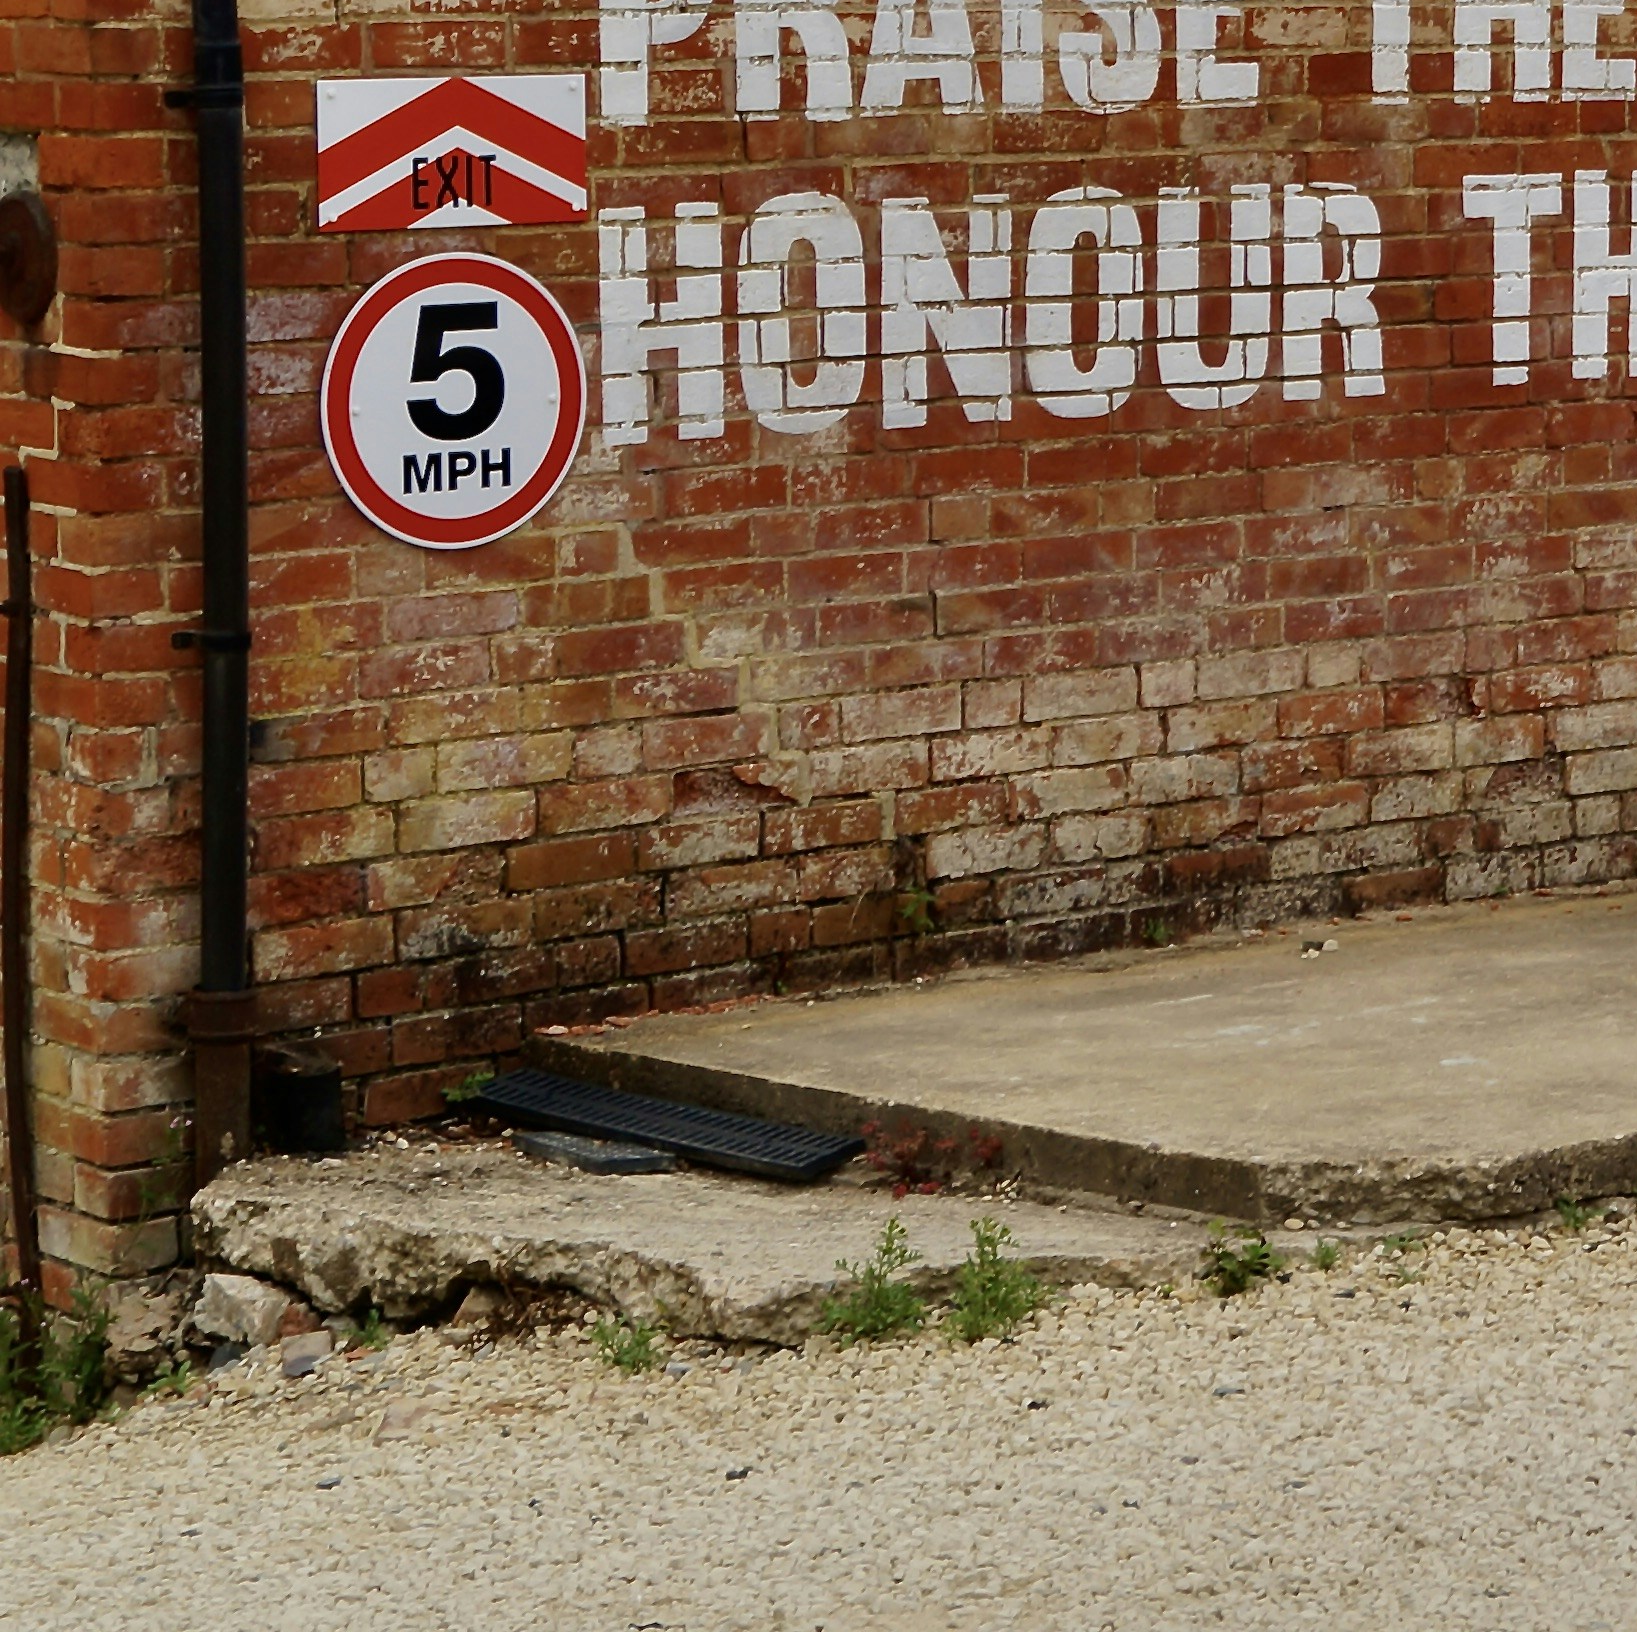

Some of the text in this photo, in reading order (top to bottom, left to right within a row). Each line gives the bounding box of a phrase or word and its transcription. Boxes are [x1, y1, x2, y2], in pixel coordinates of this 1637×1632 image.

[411, 154, 497, 210] EXIT
[600, 182, 1386, 445] HONOUR
[406, 300, 506, 443] 5
[402, 447, 512, 495] MPH
